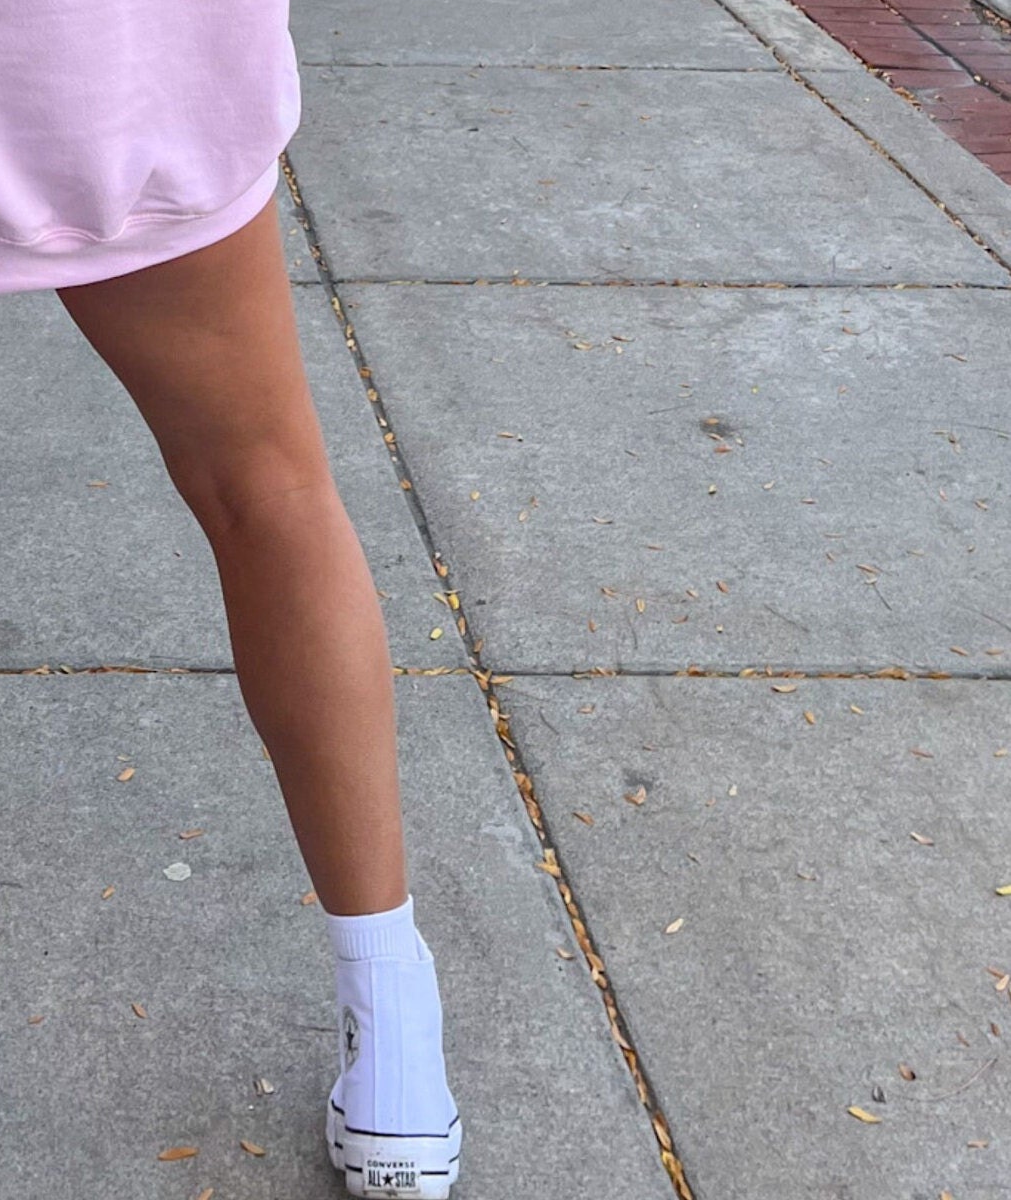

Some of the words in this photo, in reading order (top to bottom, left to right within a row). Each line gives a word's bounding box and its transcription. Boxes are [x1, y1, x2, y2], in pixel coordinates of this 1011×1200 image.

[367, 1159, 415, 1169] CONVERSE
[368, 1169, 381, 1188] ALL
[395, 1170, 416, 1188] STAR
